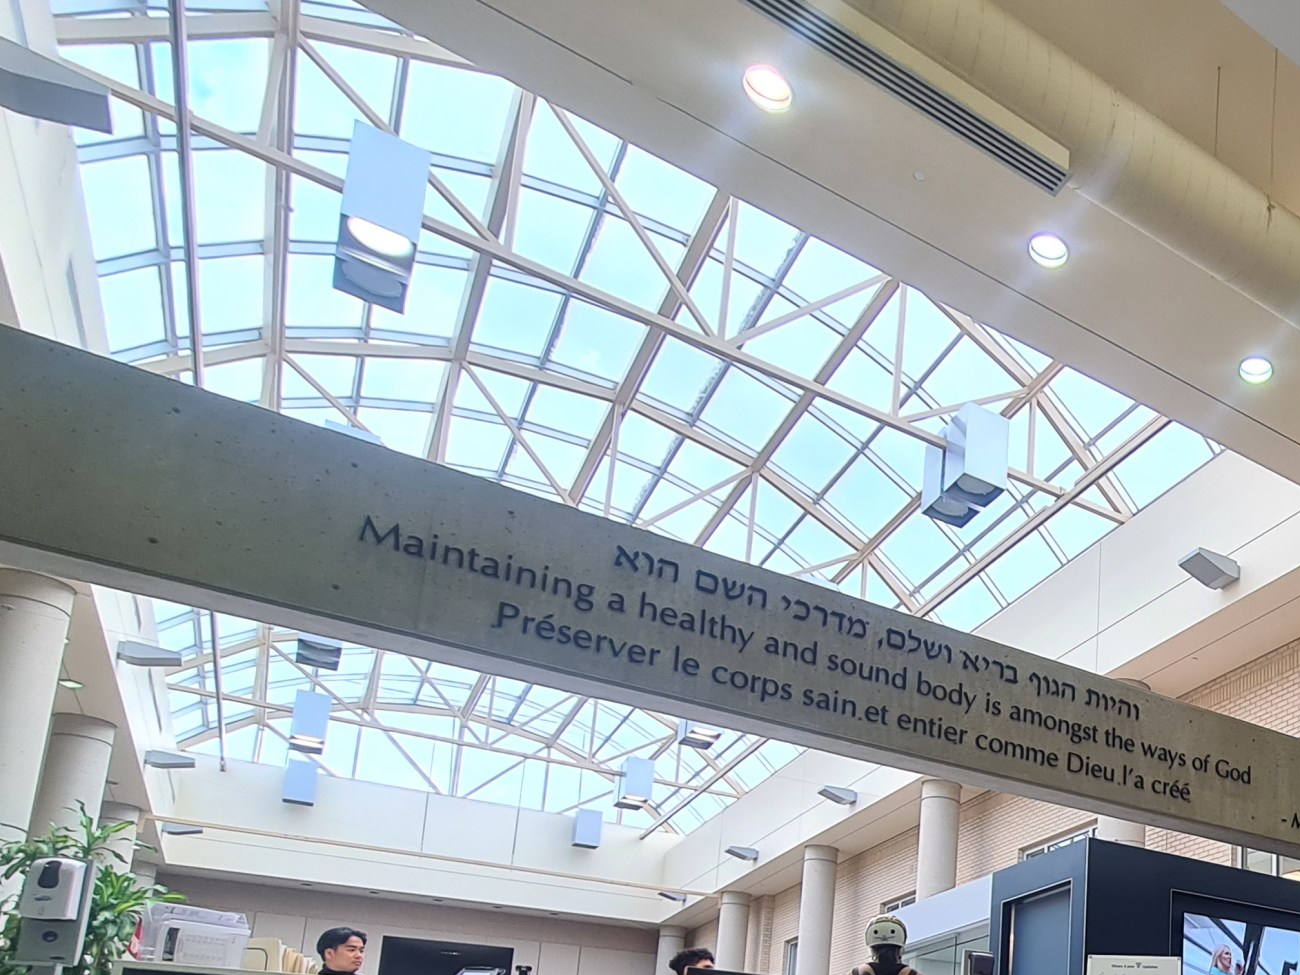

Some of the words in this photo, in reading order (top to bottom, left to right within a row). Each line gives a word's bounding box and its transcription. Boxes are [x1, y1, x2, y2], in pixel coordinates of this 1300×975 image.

[613, 544, 680, 584] הוא
[694, 569, 768, 609] השם
[780, 594, 868, 639] מדרכי
[358, 514, 596, 612] Maintaining
[607, 592, 626, 613] a
[638, 591, 755, 654] healthy
[764, 636, 818, 666] and
[827, 652, 908, 691] sound
[916, 671, 977, 715] body
[985, 692, 1002, 717] is
[1009, 704, 1099, 744] amongst
[1104, 727, 1135, 753] the
[1140, 741, 1187, 770] ways
[1191, 754, 1211, 774] of
[1214, 758, 1251, 785] God
[959, 650, 1019, 684] בריא
[497, 601, 661, 667] Préserver
[673, 645, 700, 677] le
[711, 664, 793, 704] corps
[864, 704, 889, 726] et
[896, 713, 969, 745] entier
[974, 733, 1059, 767] comme
[1150, 779, 1191, 802] créé
[1028, 671, 1076, 702] הגוף
[1084, 687, 1141, 721] והיות
